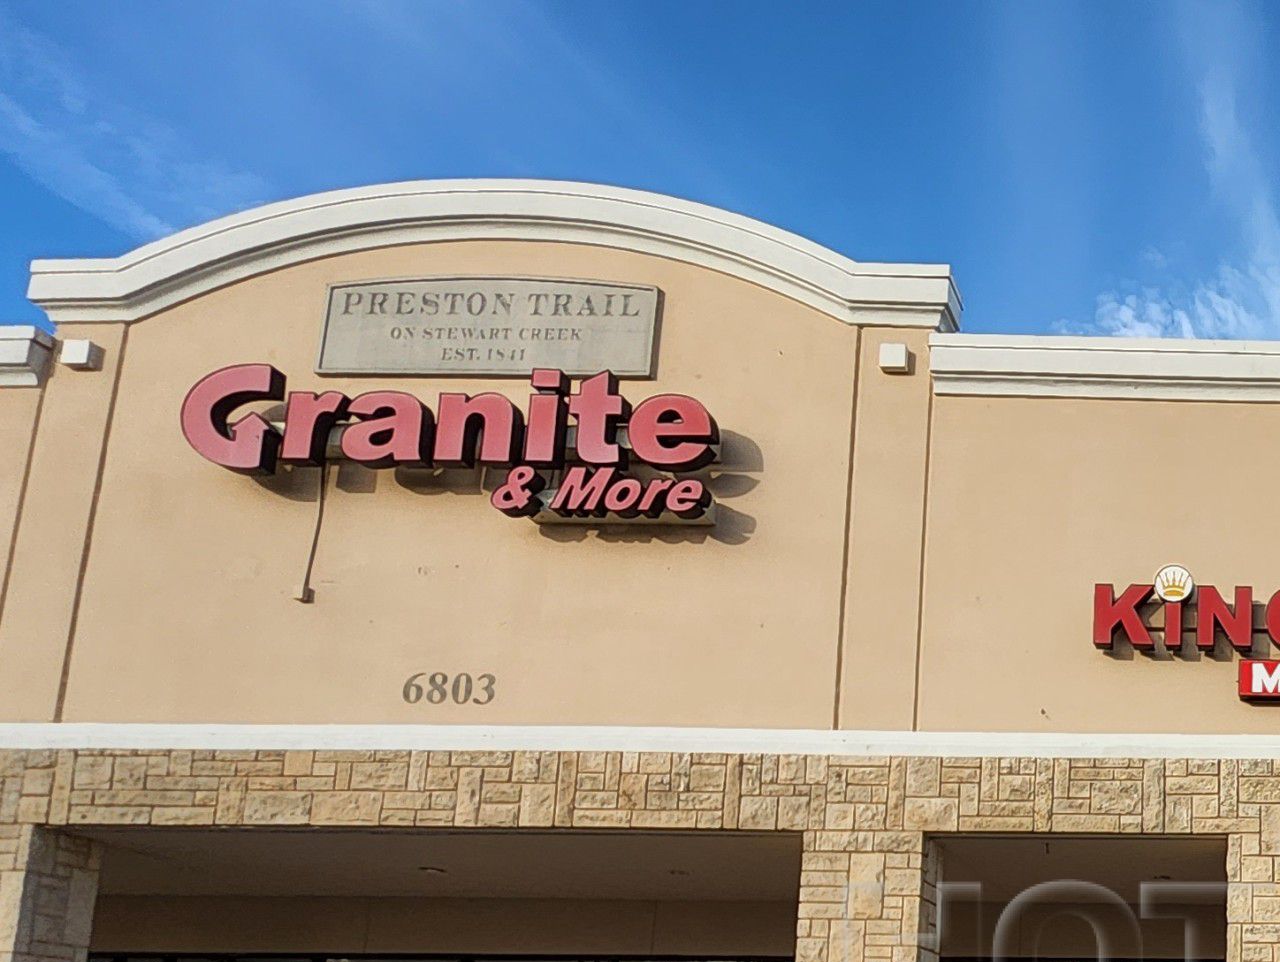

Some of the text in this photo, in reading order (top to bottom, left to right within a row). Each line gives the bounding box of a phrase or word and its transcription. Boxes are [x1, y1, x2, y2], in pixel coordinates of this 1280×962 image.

[341, 291, 641, 318] PRESTON TRAIL
[390, 326, 583, 341] ON STEWART CREEK
[440, 347, 481, 362] EST.
[180, 362, 721, 470] Granite
[490, 465, 707, 514] & More
[402, 672, 497, 706] 6803
